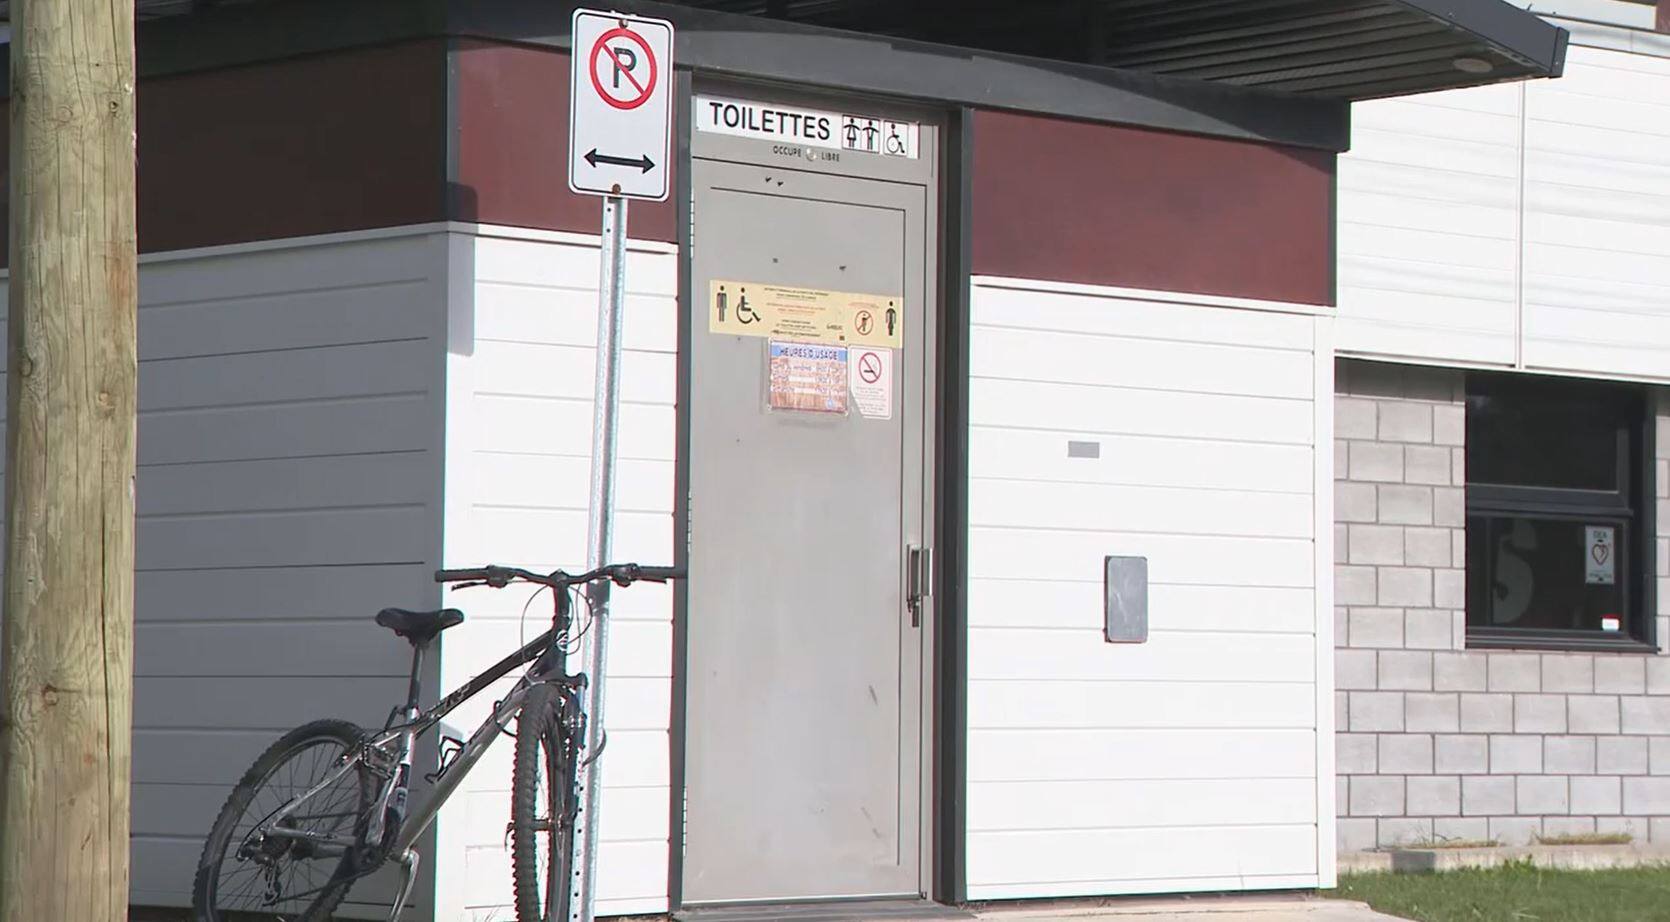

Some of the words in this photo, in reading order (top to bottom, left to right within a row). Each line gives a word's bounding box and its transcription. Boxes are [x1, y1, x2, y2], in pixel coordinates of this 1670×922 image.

[612, 47, 637, 88] P
[709, 102, 831, 141] TOILETTES
[821, 151, 839, 162] LIBRE
